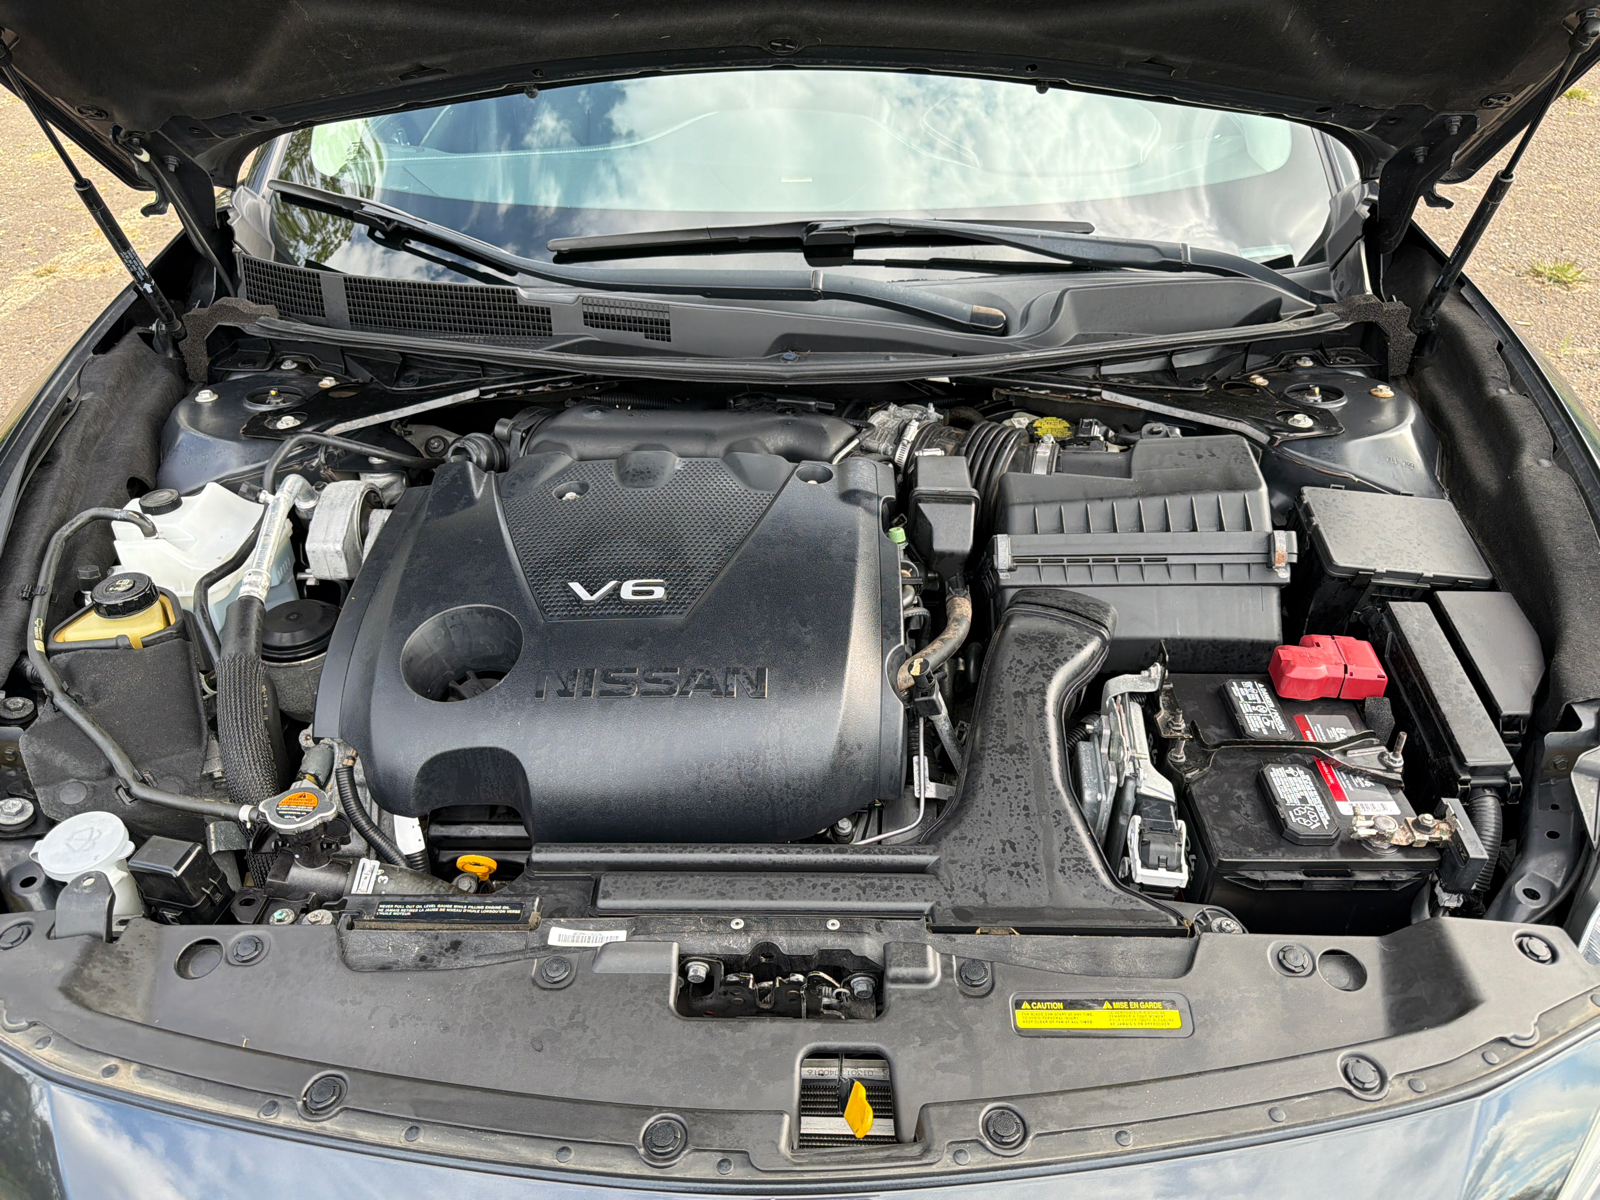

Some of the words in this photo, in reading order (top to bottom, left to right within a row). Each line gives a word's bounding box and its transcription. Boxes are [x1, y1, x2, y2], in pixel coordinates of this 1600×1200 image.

[567, 578, 667, 604] V6
[535, 666, 769, 700] NISSAN
[1031, 1002, 1064, 1010] CAUTION
